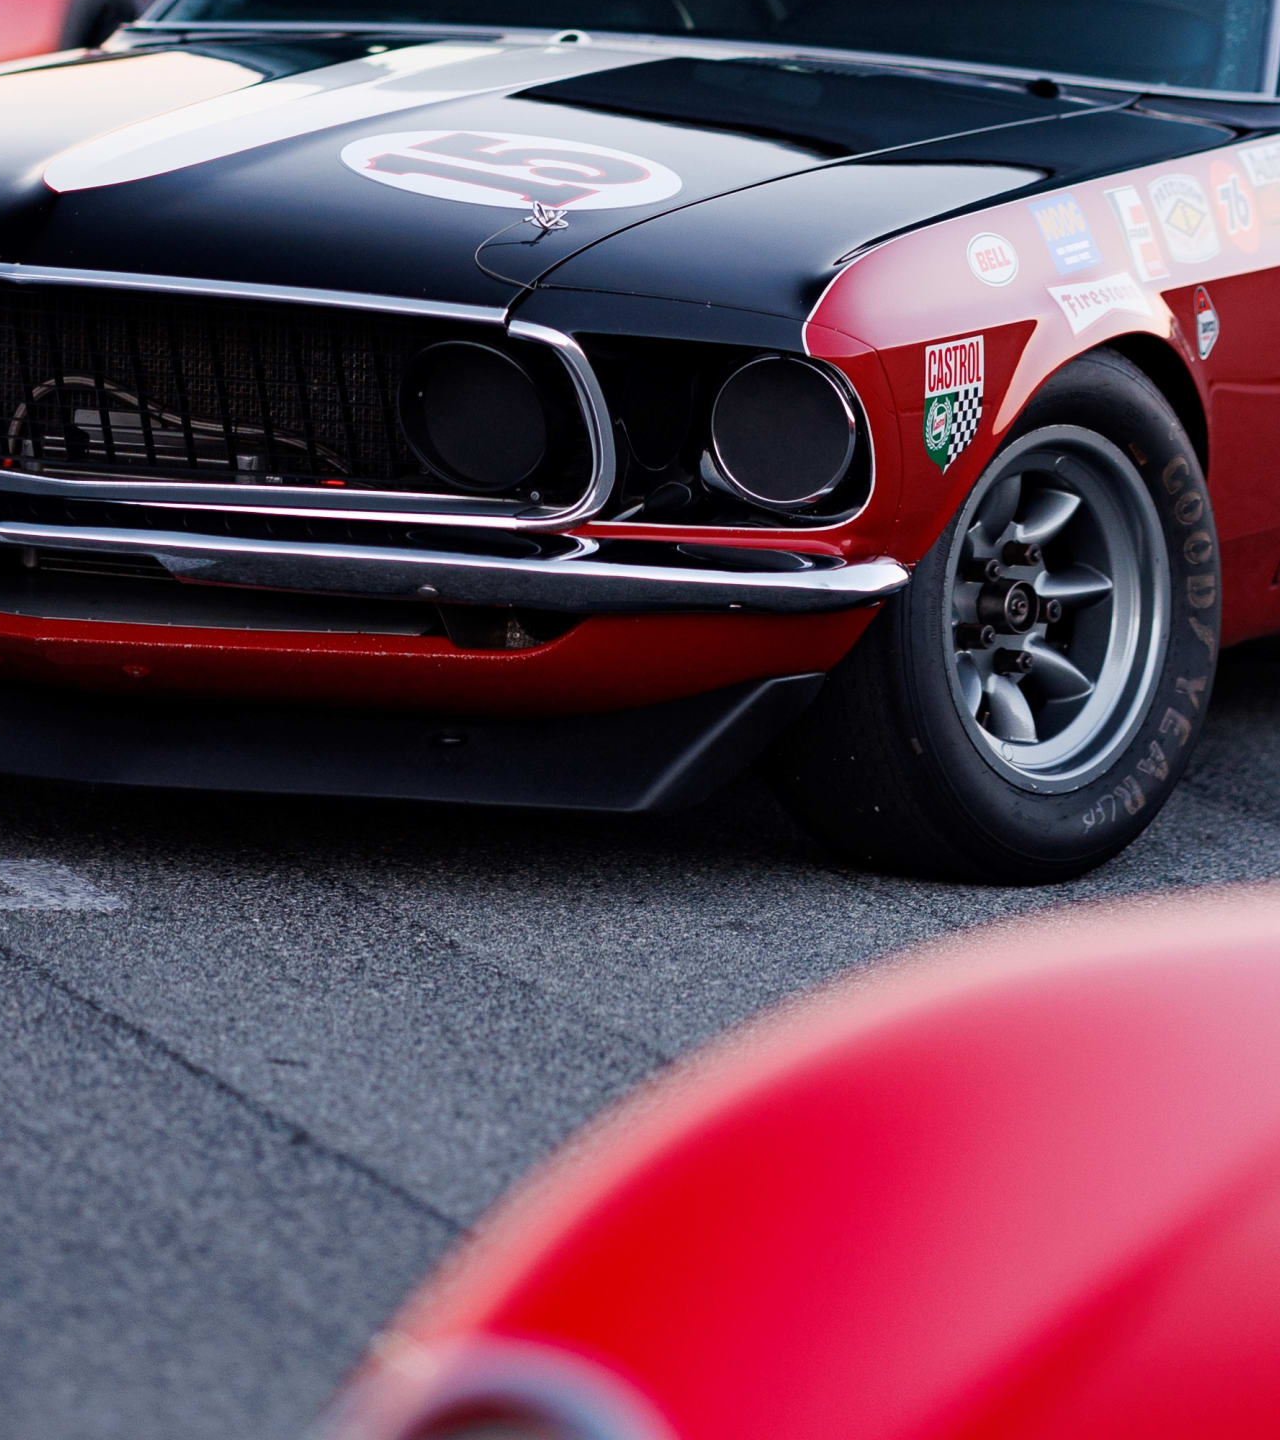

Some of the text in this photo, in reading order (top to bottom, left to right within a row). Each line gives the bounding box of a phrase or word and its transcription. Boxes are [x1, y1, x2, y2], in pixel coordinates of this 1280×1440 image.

[365, 132, 651, 208] 15
[1217, 176, 1250, 232] 76
[975, 245, 1012, 273] BELL
[928, 341, 982, 393] CASTROL
